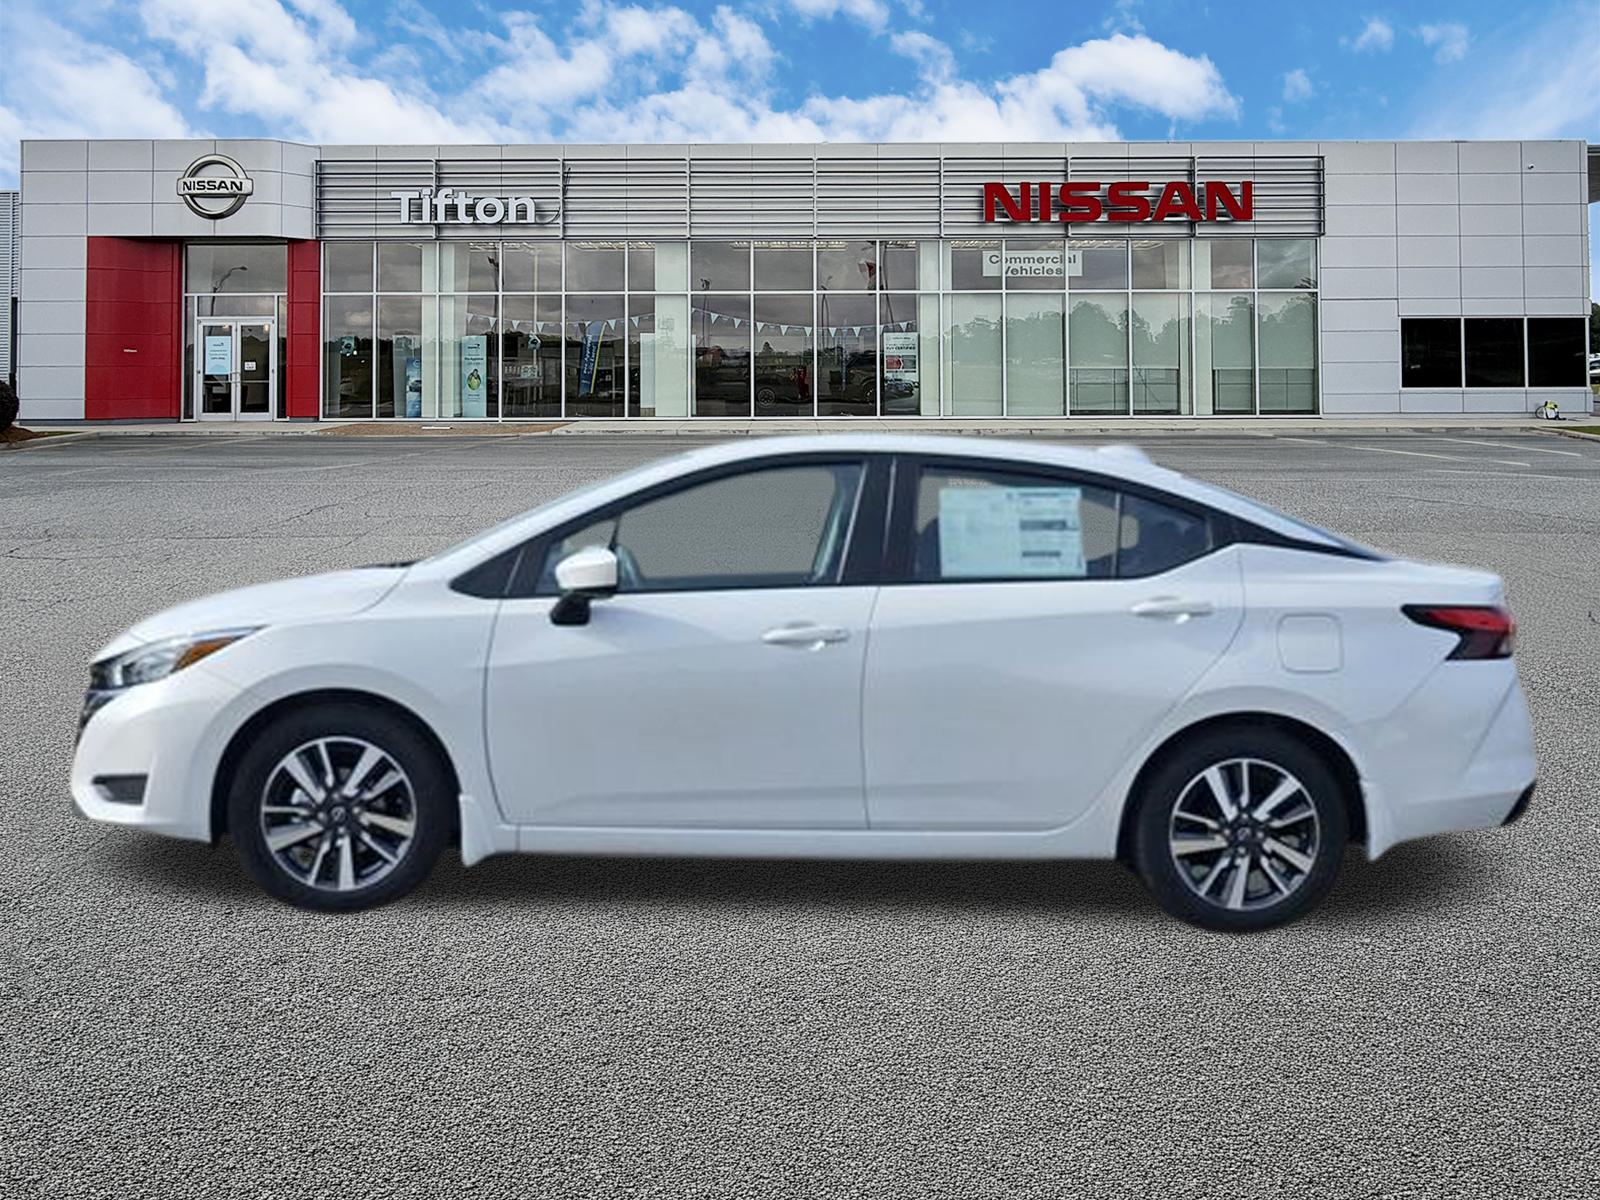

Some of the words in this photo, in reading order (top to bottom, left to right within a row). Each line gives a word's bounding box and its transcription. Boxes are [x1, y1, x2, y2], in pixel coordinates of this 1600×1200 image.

[182, 180, 243, 192] NISSAN
[984, 181, 1253, 222] NISSAN
[391, 188, 536, 224] Tifton
